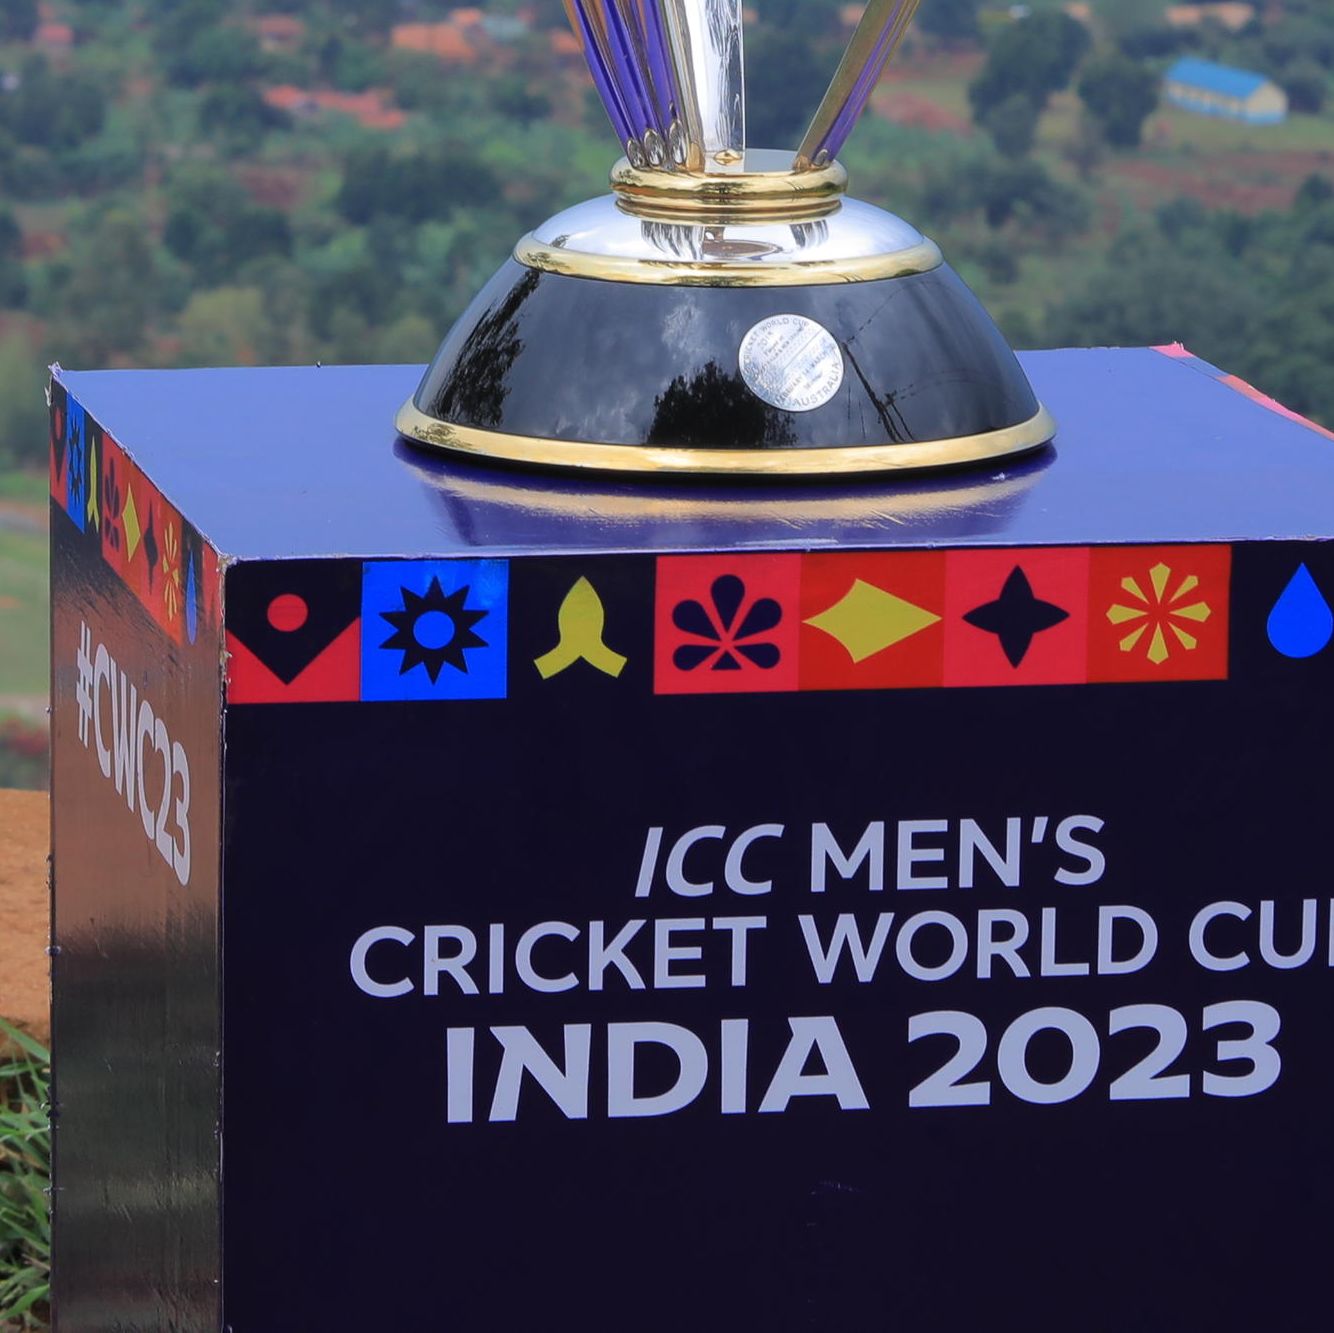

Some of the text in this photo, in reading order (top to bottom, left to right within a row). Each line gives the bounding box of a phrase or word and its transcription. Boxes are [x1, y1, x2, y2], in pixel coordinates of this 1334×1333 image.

[77, 620, 191, 886] #CWC23
[635, 814, 1106, 898] ICC MEN'S
[349, 915, 768, 999] CRICKET
[798, 904, 1159, 985] WORLD
[447, 999, 1282, 1124] INDIA 2023
